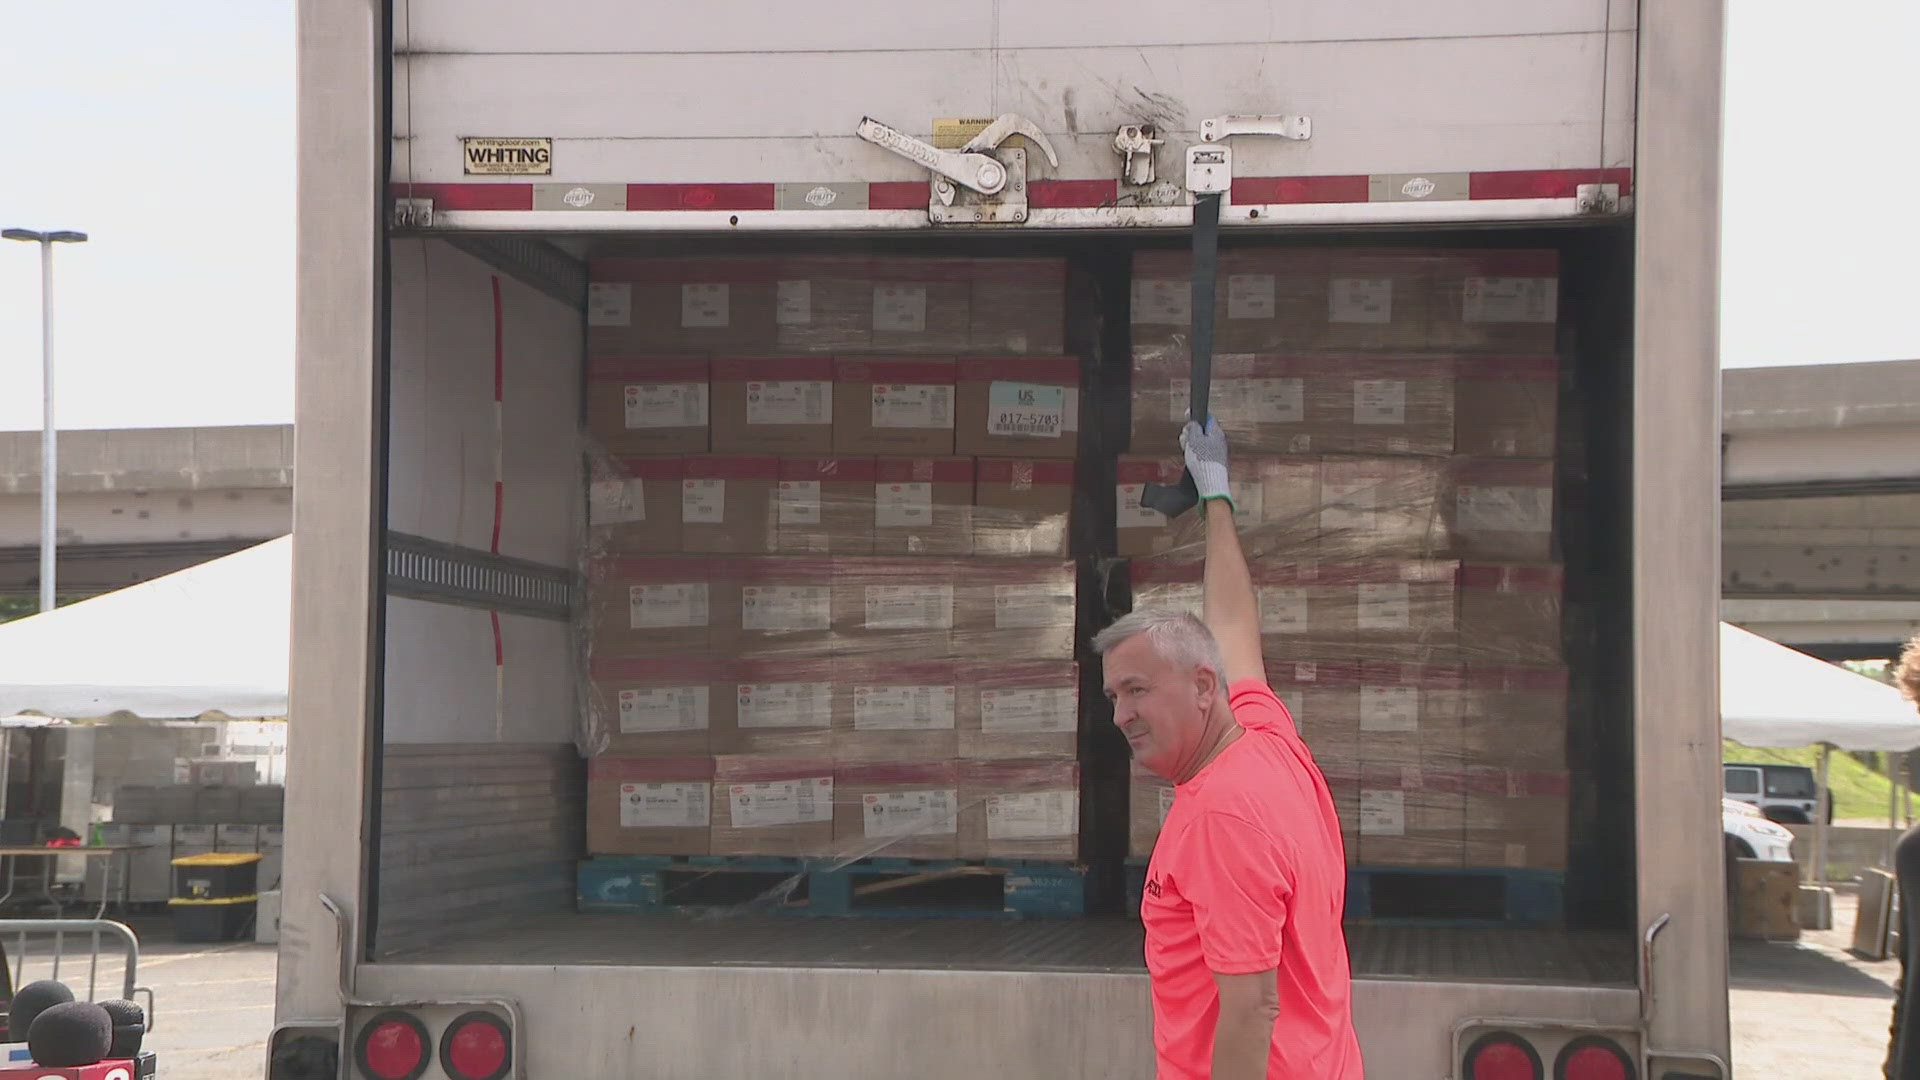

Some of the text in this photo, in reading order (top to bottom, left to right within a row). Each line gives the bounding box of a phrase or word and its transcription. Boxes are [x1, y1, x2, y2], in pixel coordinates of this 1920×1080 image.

[476, 139, 540, 147] whitingdoor.com
[467, 148, 549, 163] WHITING
[1000, 412, 1059, 425] 017-5703
